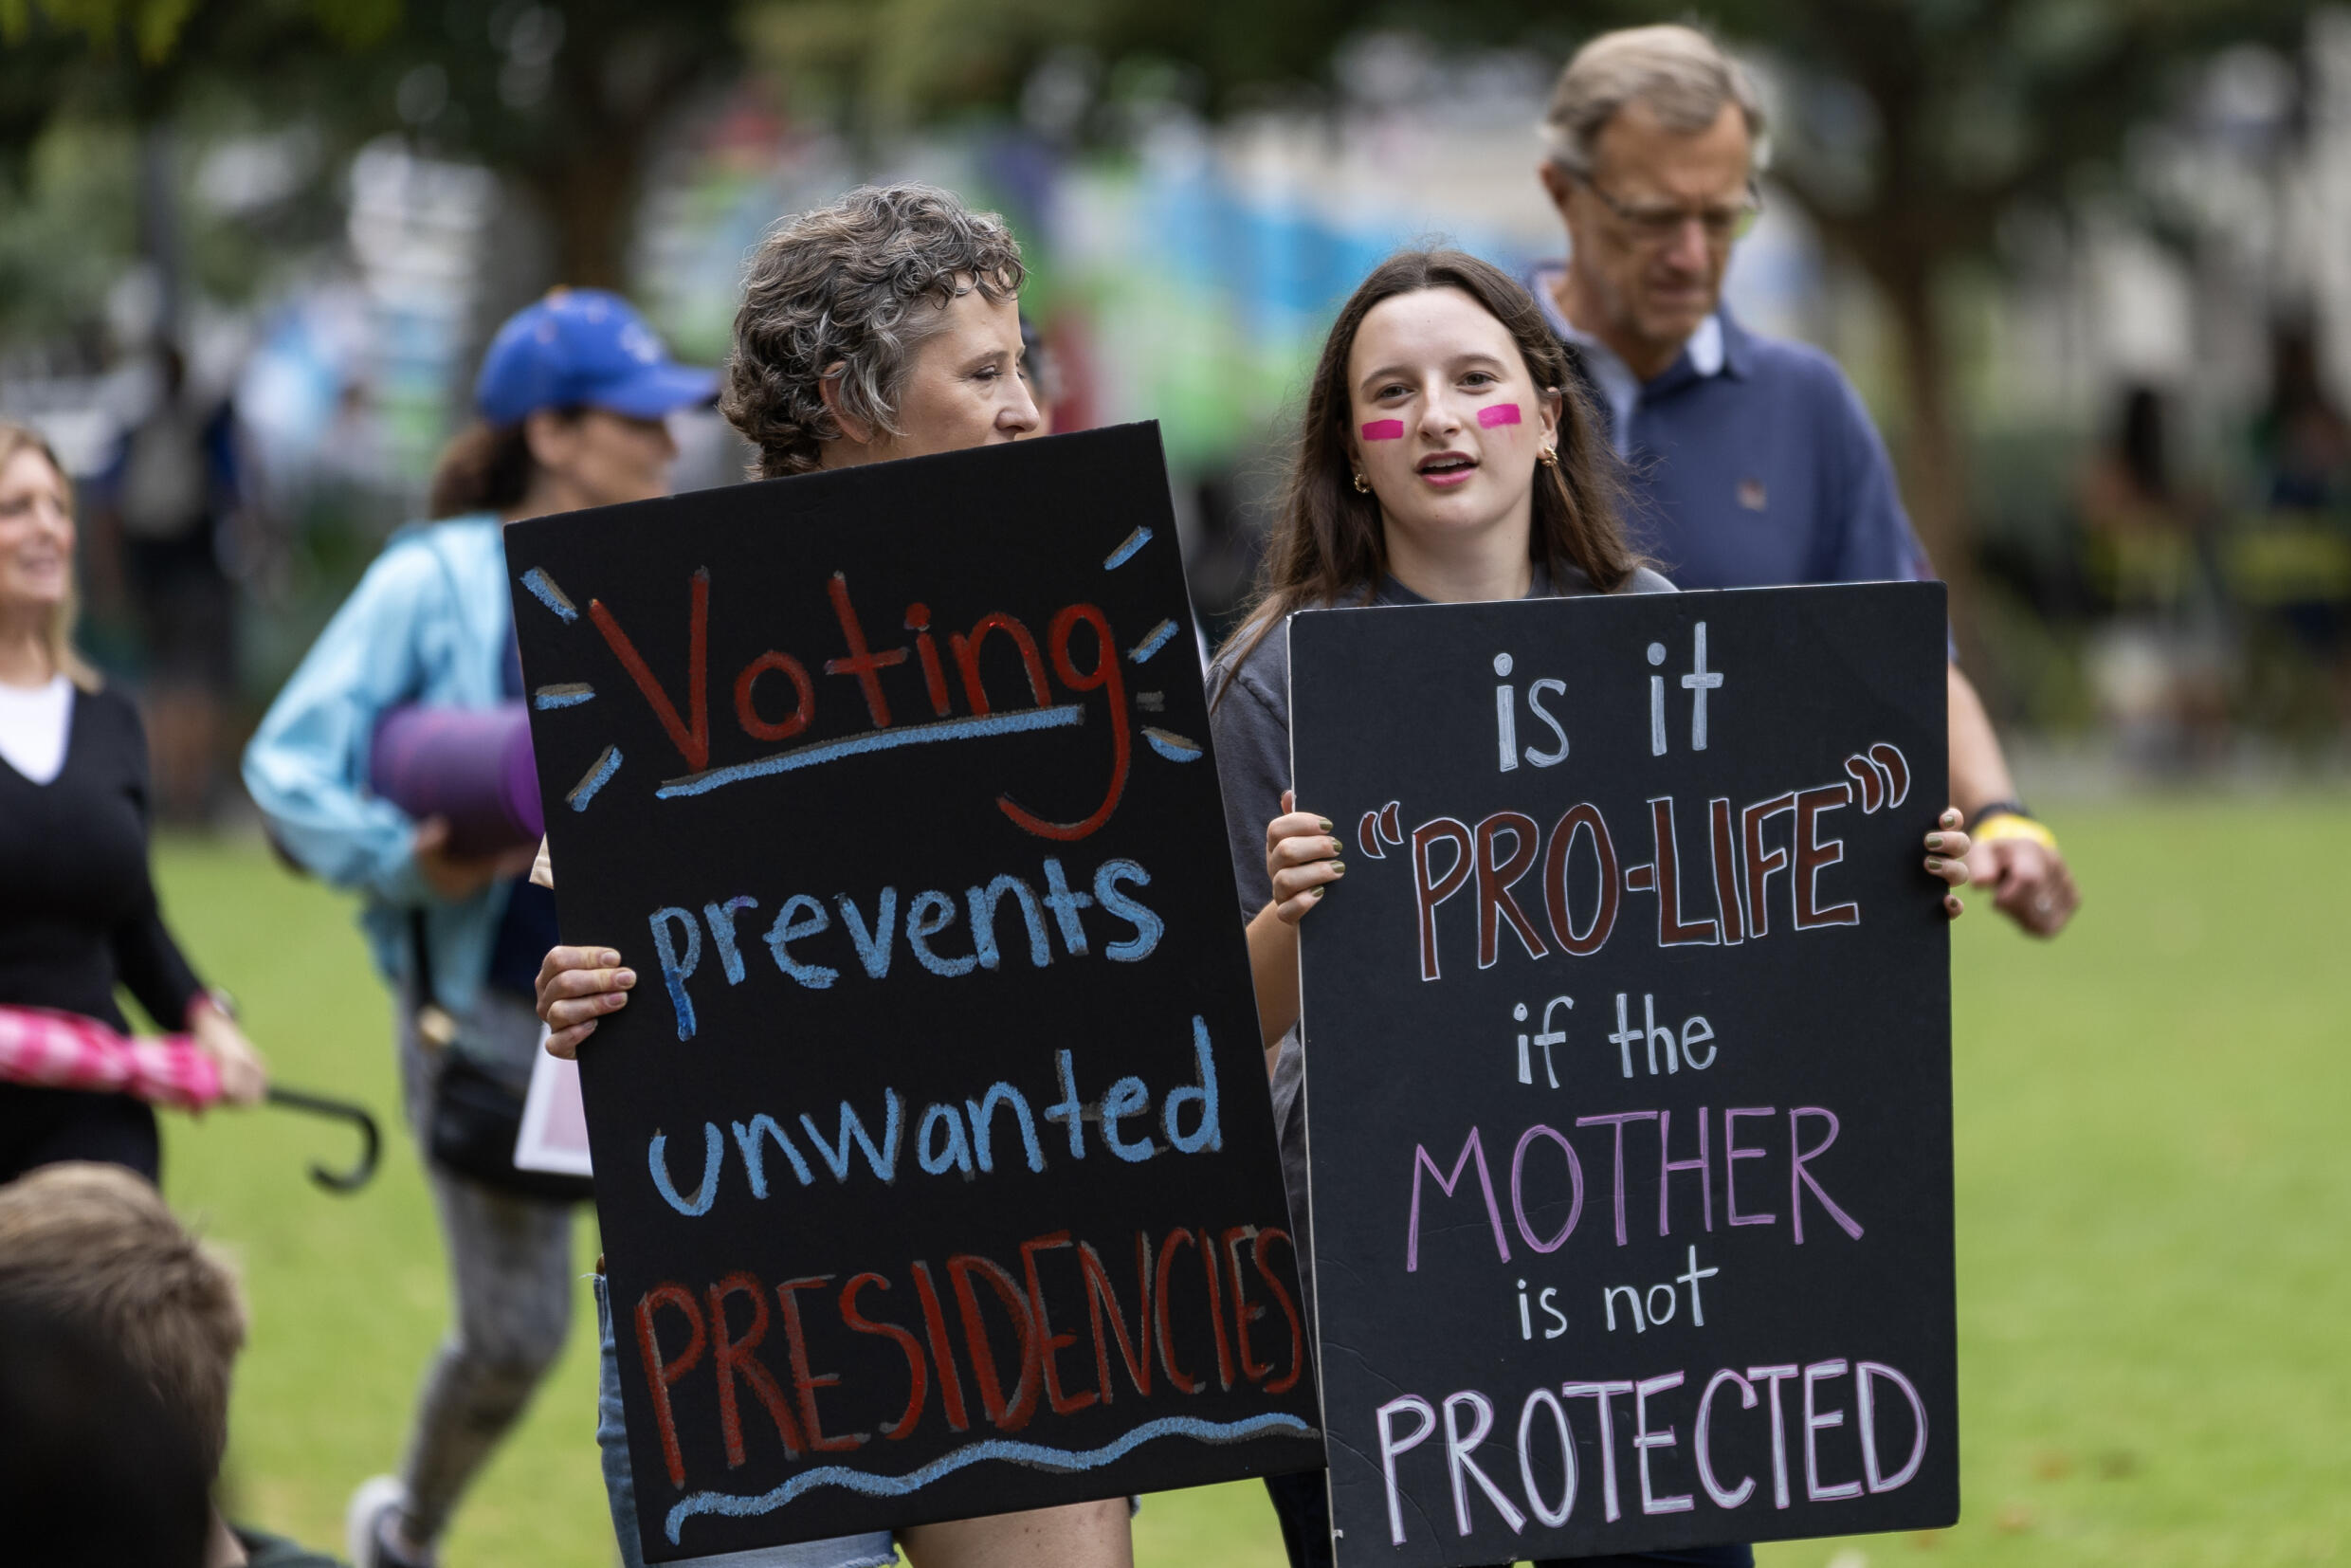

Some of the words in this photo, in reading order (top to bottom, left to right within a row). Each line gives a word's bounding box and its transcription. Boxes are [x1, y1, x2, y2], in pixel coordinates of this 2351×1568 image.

[590, 567, 1130, 841] Voting
[1494, 652, 1570, 772] is
[1647, 622, 1723, 757] it
[649, 856, 1165, 1041] prevents
[1513, 995, 1574, 1088] if
[1609, 994, 1717, 1078] the
[648, 1015, 1223, 1215] unwanted
[1407, 1106, 1864, 1272] MOTHER
[634, 1224, 1303, 1489] PRESIDENCIES
[1517, 1279, 1568, 1340] is
[1605, 1245, 1719, 1334] not
[1376, 1358, 1928, 1545] PROTECTED
